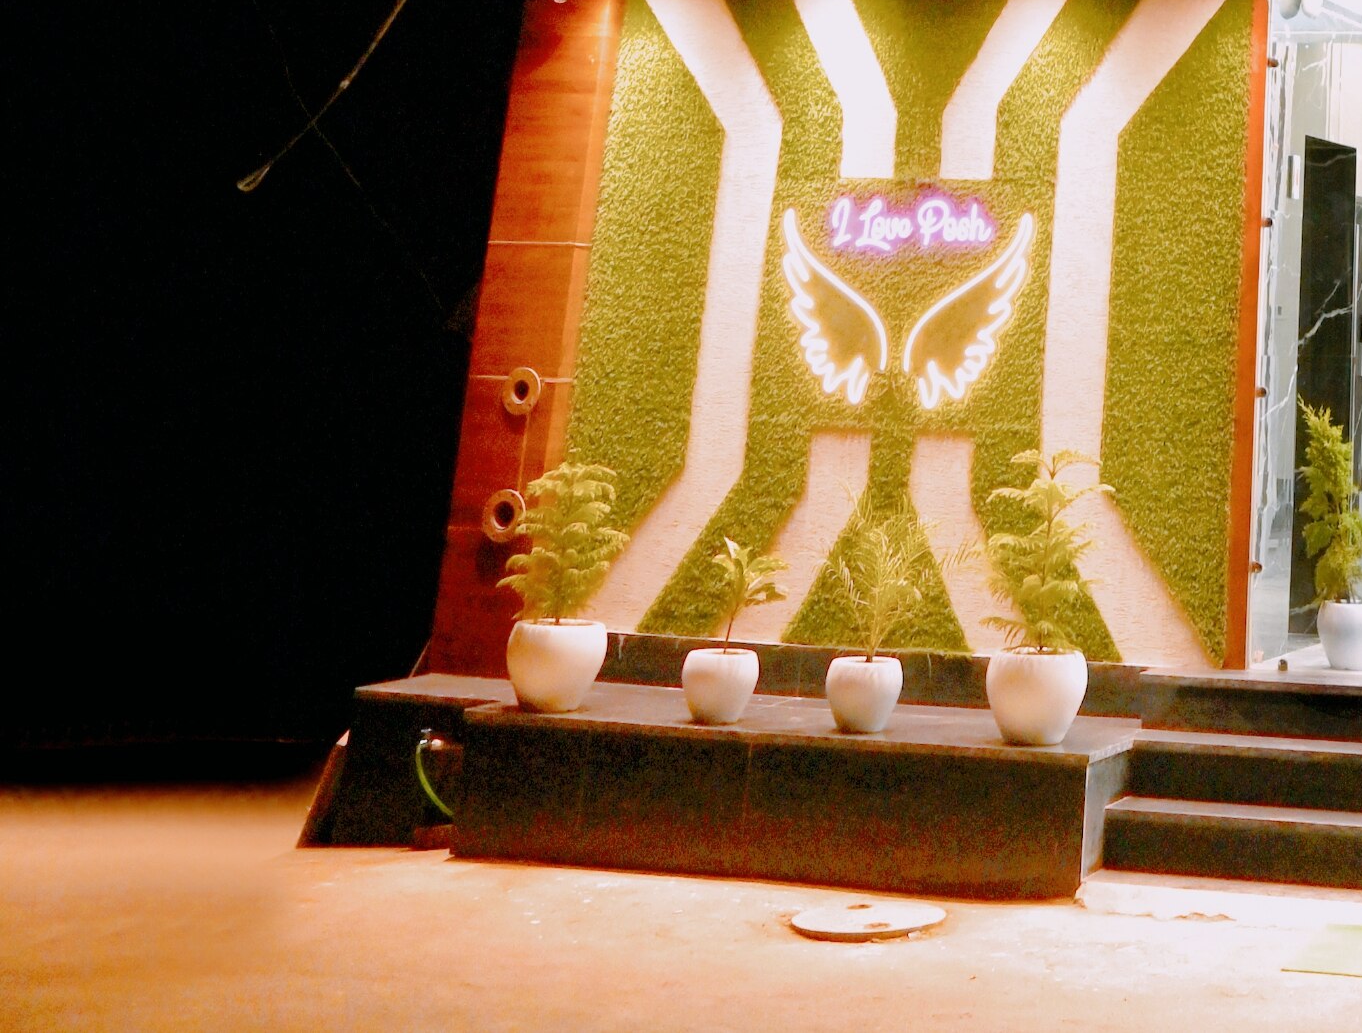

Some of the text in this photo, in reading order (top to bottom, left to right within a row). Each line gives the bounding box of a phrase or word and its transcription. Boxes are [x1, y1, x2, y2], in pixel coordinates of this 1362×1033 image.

[831, 197, 993, 252] I Love Posh
